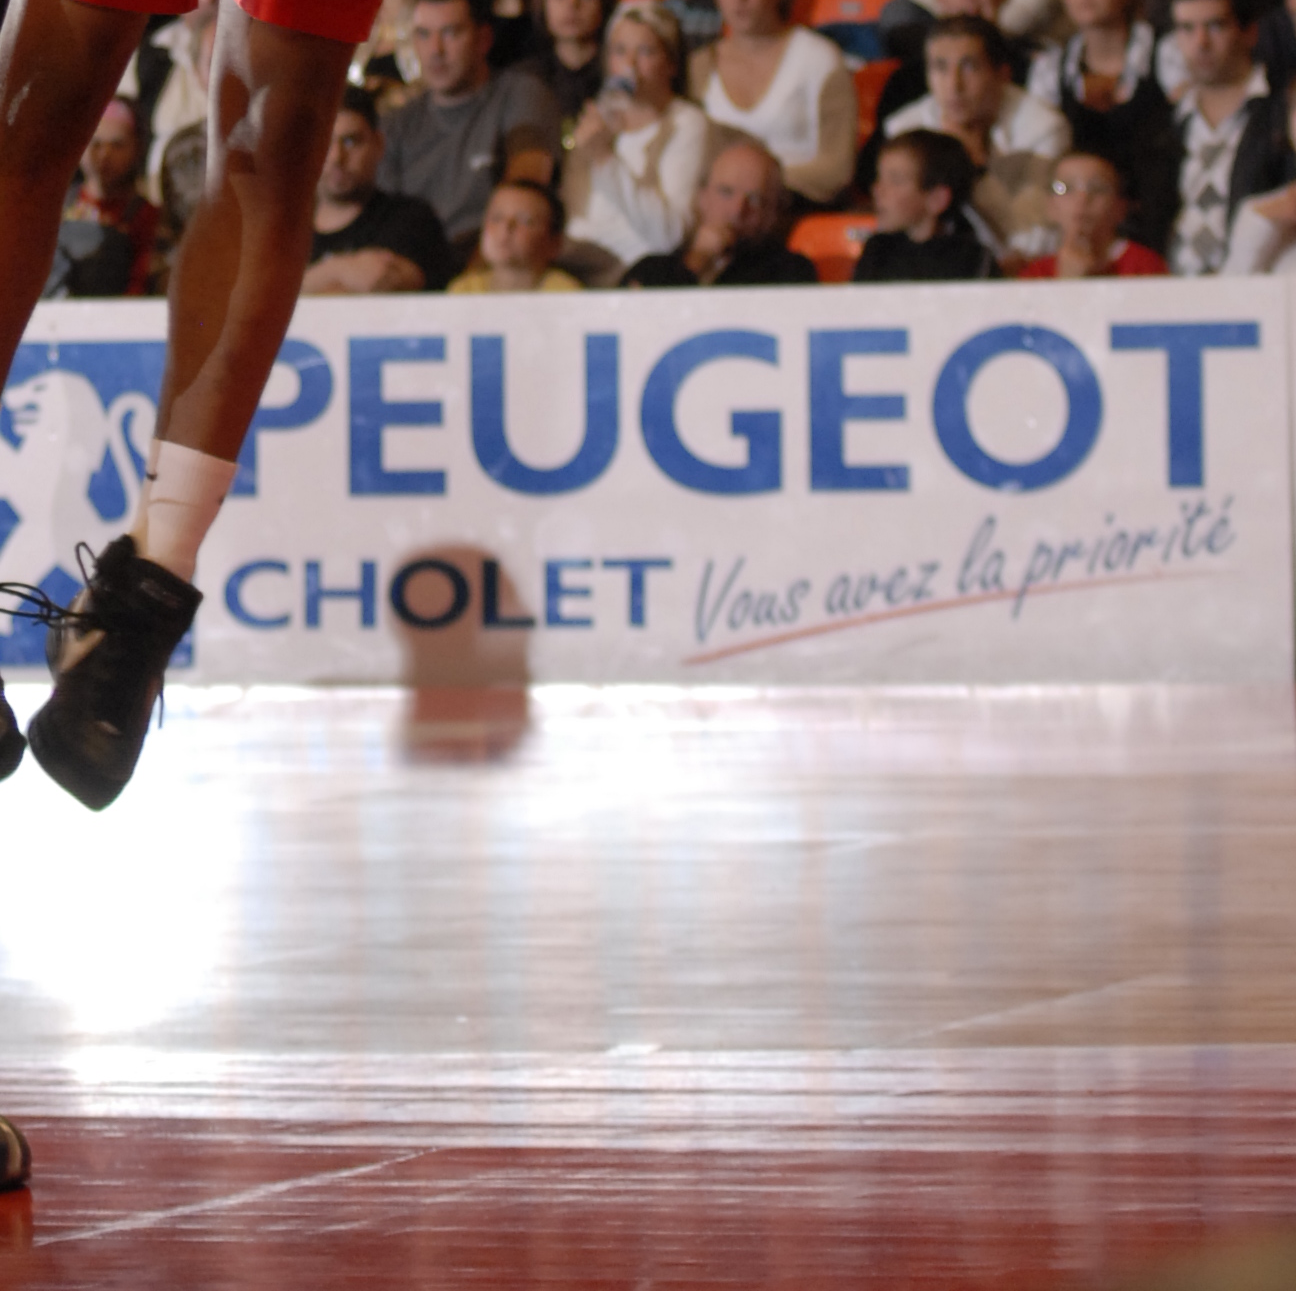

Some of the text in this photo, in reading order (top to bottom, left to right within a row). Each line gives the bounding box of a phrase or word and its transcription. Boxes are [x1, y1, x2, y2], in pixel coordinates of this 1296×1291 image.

[231, 321, 1261, 497] PEUGEOT
[223, 559, 672, 630] CHOLET
[694, 497, 1236, 643] Vous avez la priorité
